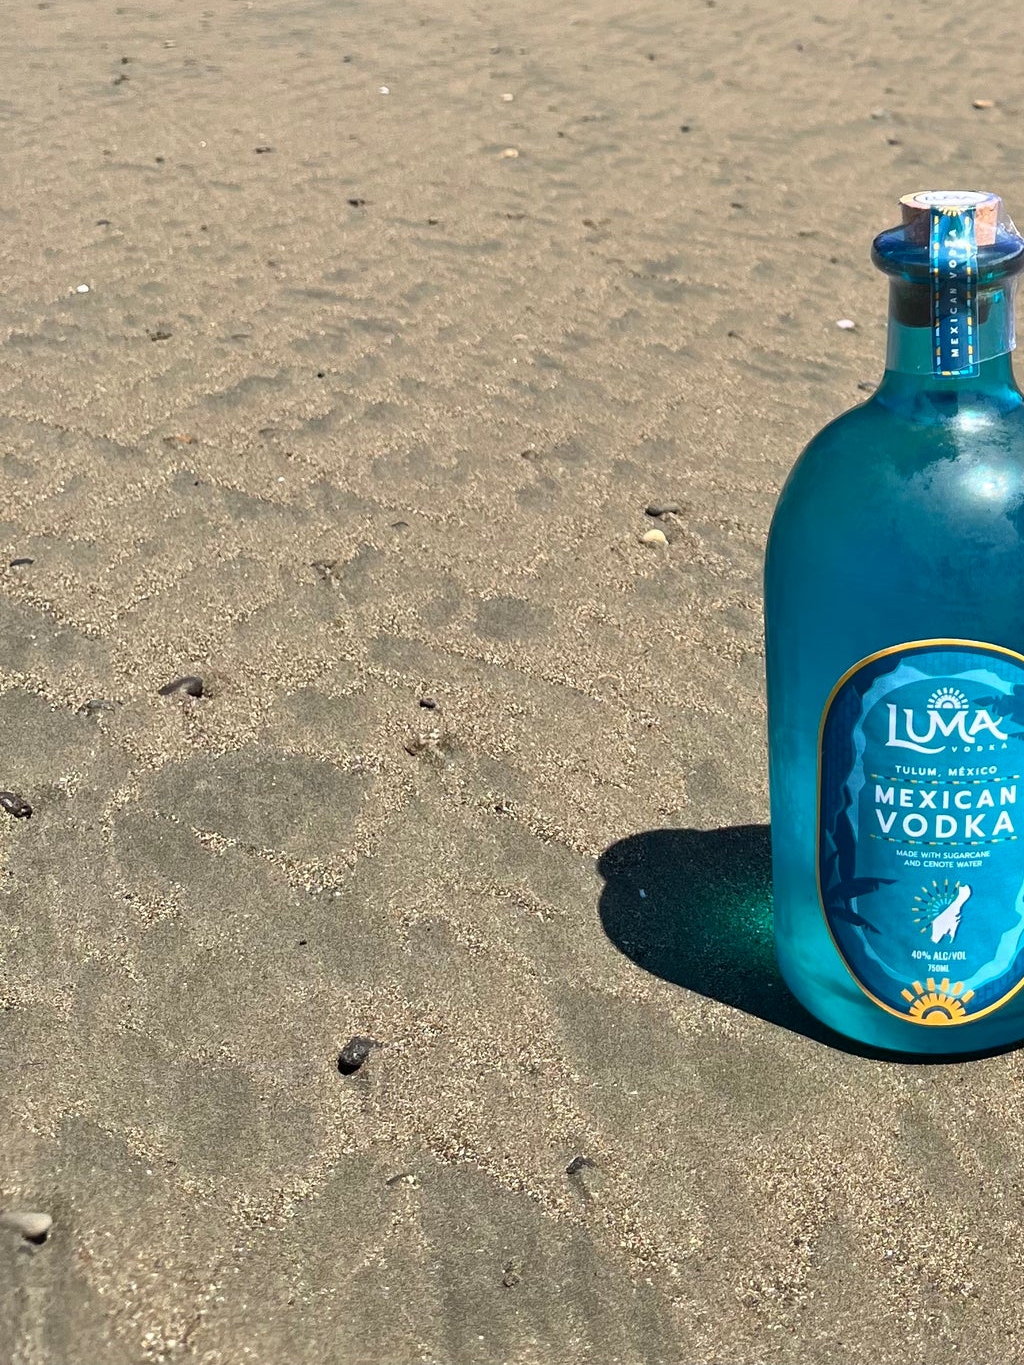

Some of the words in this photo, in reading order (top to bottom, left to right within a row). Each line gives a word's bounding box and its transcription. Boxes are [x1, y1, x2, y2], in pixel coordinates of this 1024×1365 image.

[948, 229, 958, 279] VODA
[950, 288, 960, 357] MEXICAN
[885, 702, 1008, 754] LUMA
[951, 742, 1008, 753] VODKA
[895, 764, 942, 777] TULUM,
[948, 763, 998, 777] MÉXICO
[874, 784, 1016, 810] MEXICAN
[875, 808, 1015, 839] VODKA
[896, 849, 918, 859] MADE
[920, 850, 941, 859] WITH
[943, 849, 991, 859] SUGARCANE
[904, 859, 921, 868] AND
[923, 860, 954, 869] CENOTE
[956, 859, 983, 868] WATER
[911, 950, 931, 960] 40%
[933, 950, 967, 961] ALC/VOL
[927, 963, 950, 973] 750ML
